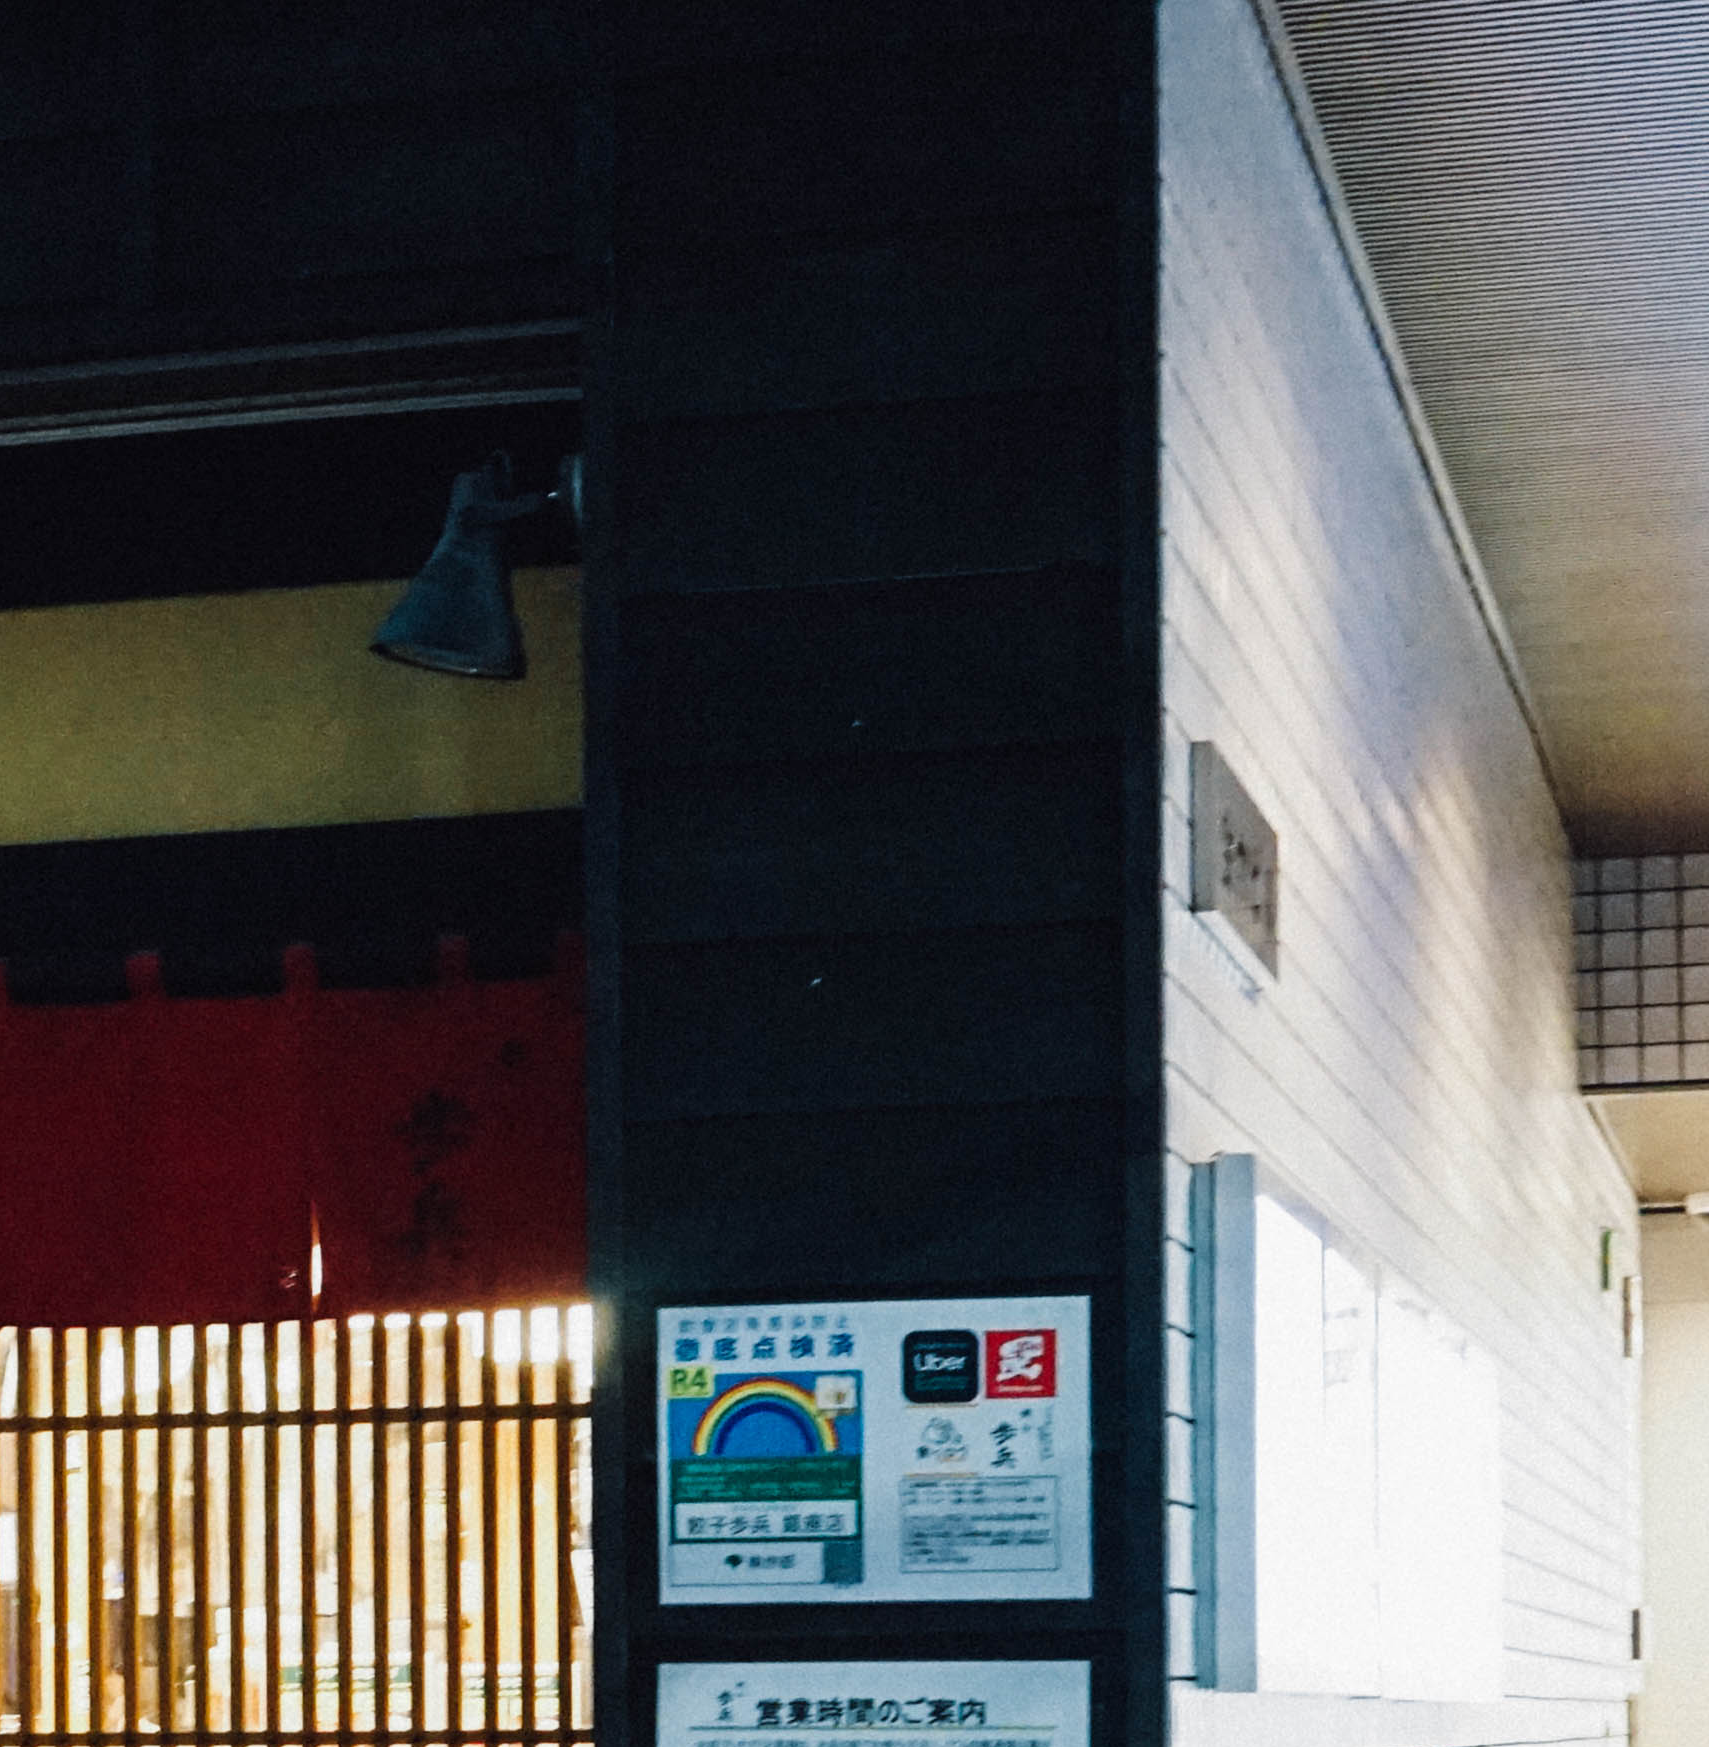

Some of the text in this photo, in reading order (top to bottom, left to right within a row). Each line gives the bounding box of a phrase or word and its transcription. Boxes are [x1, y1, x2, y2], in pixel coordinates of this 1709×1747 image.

[913, 1352, 968, 1372] Uber
[670, 1368, 709, 1391] R4
[756, 1697, 987, 1727] 営業時間のご案内
